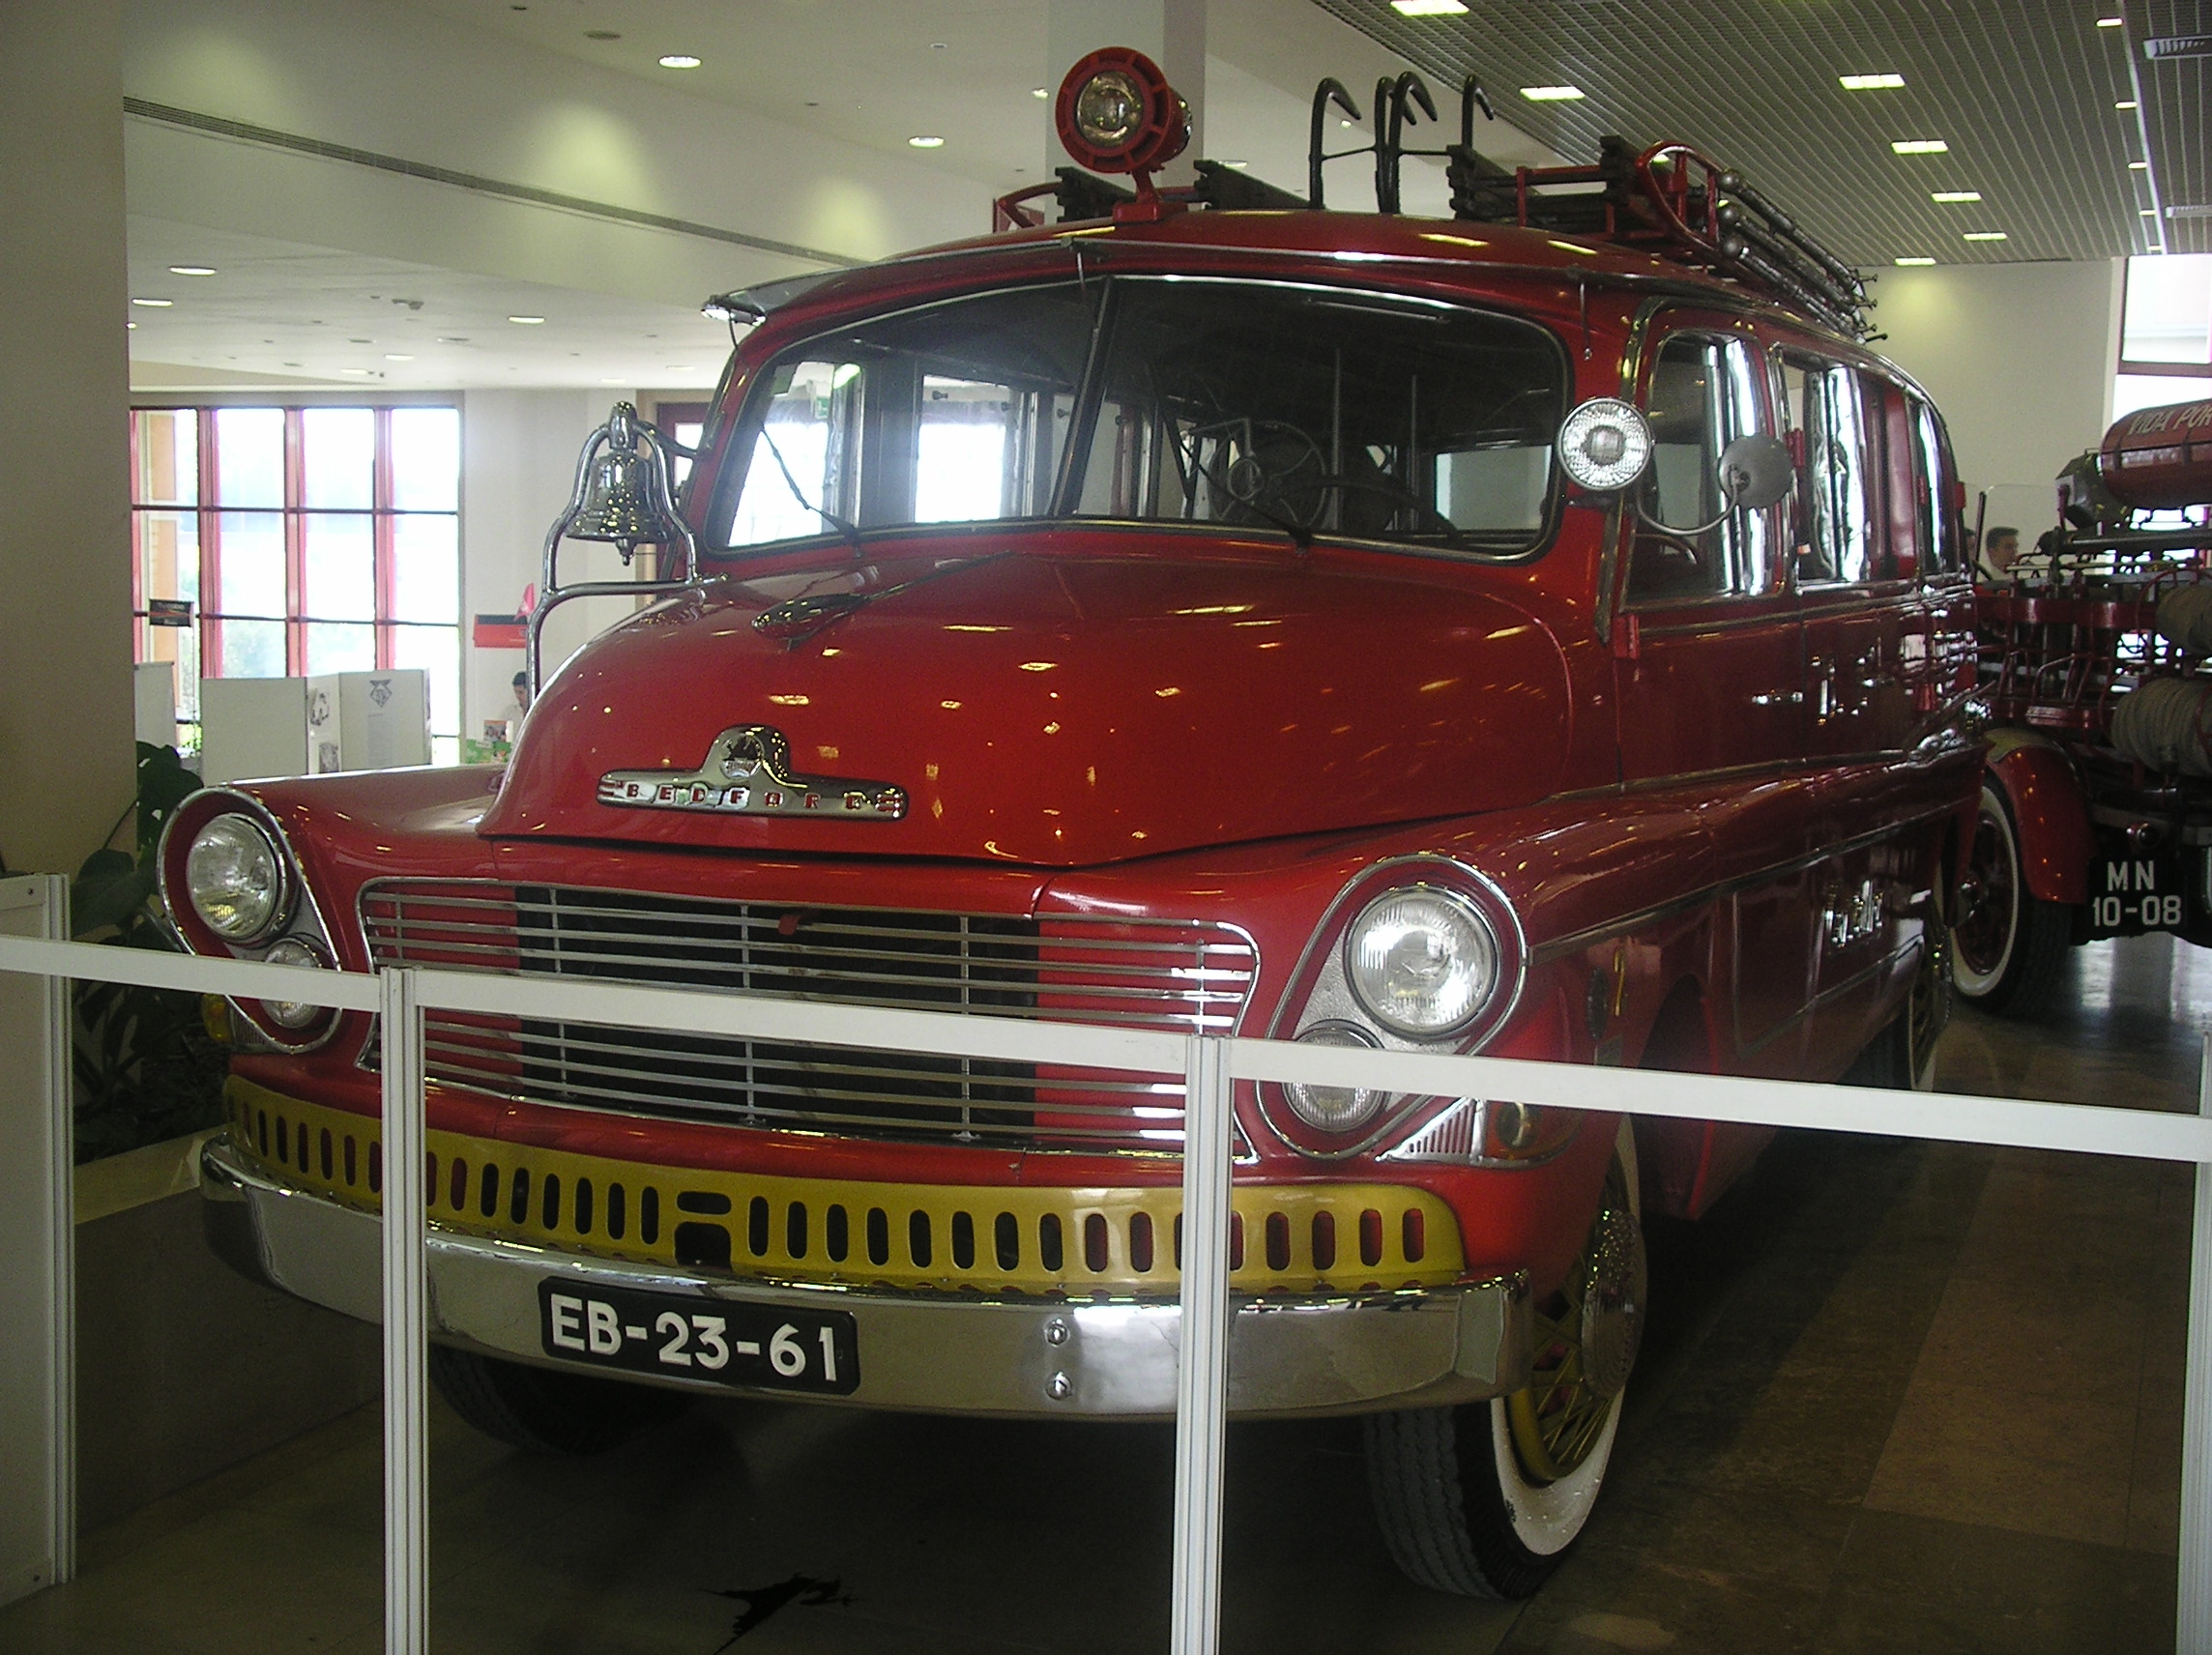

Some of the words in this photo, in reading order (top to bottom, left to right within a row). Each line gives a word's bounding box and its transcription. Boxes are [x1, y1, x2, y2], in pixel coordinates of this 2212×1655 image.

[626, 783, 863, 810] BEDFORD
[2108, 859, 2155, 891] MN
[2092, 895, 2182, 927] 10-08
[550, 1292, 837, 1382] EB-23-61
